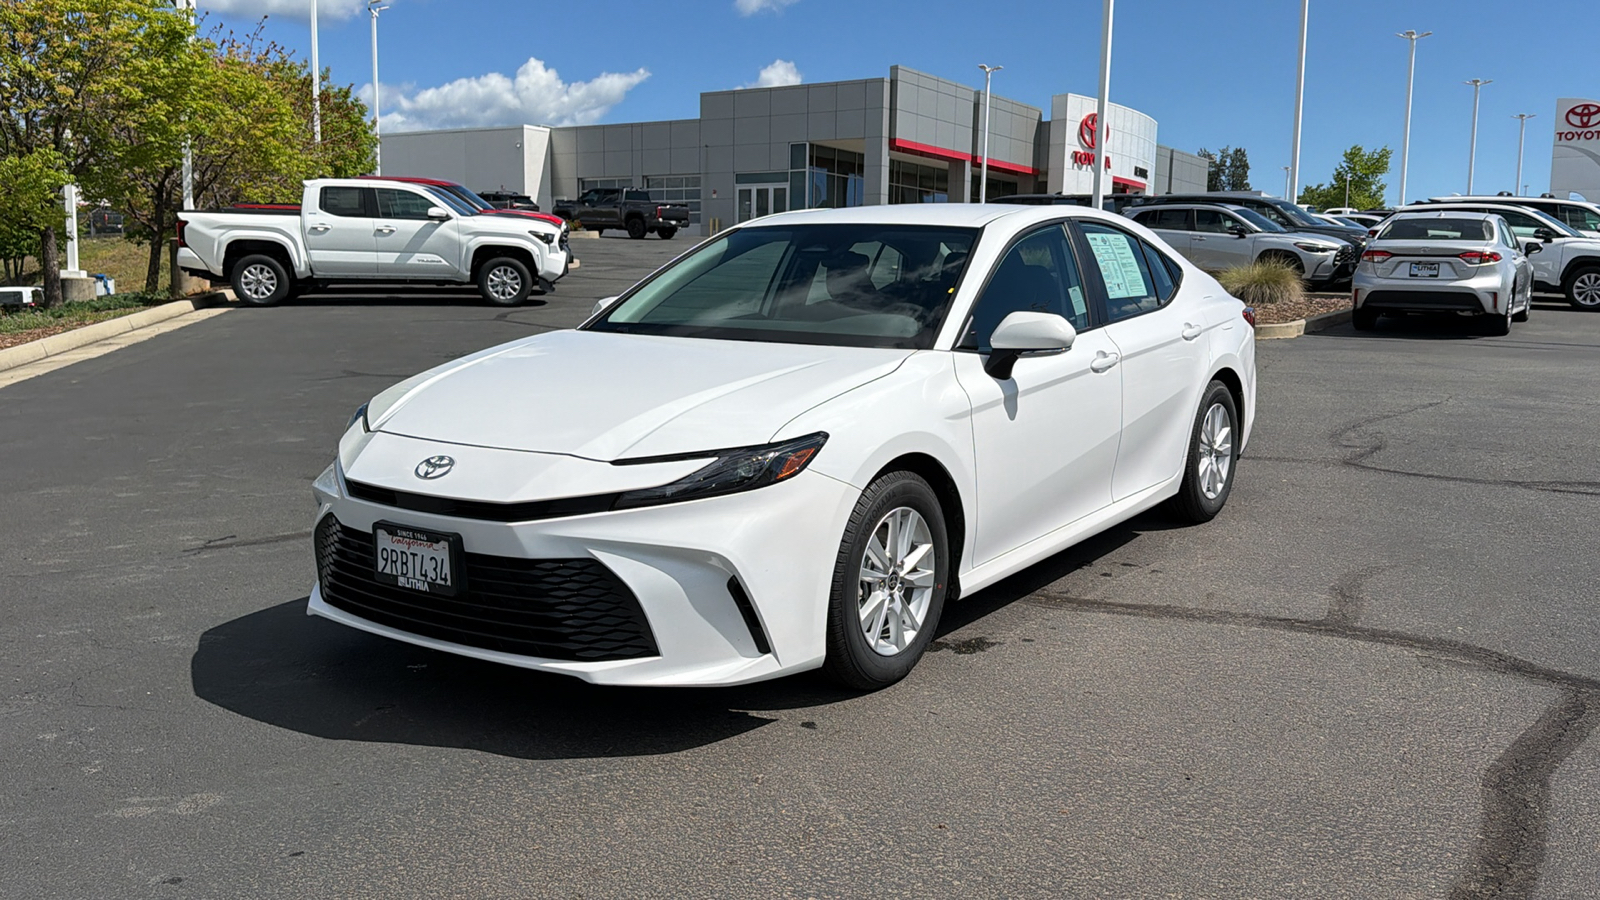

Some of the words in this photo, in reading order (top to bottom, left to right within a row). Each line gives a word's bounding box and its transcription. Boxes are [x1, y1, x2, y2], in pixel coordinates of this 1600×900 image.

[1073, 151, 1111, 169] TOYA
[861, 489, 897, 537] YOKOHAMA
[397, 529, 414, 539] SINCE
[391, 535, 439, 551] California
[380, 547, 449, 585] 9RBT434
[405, 577, 430, 592] LITHIA
